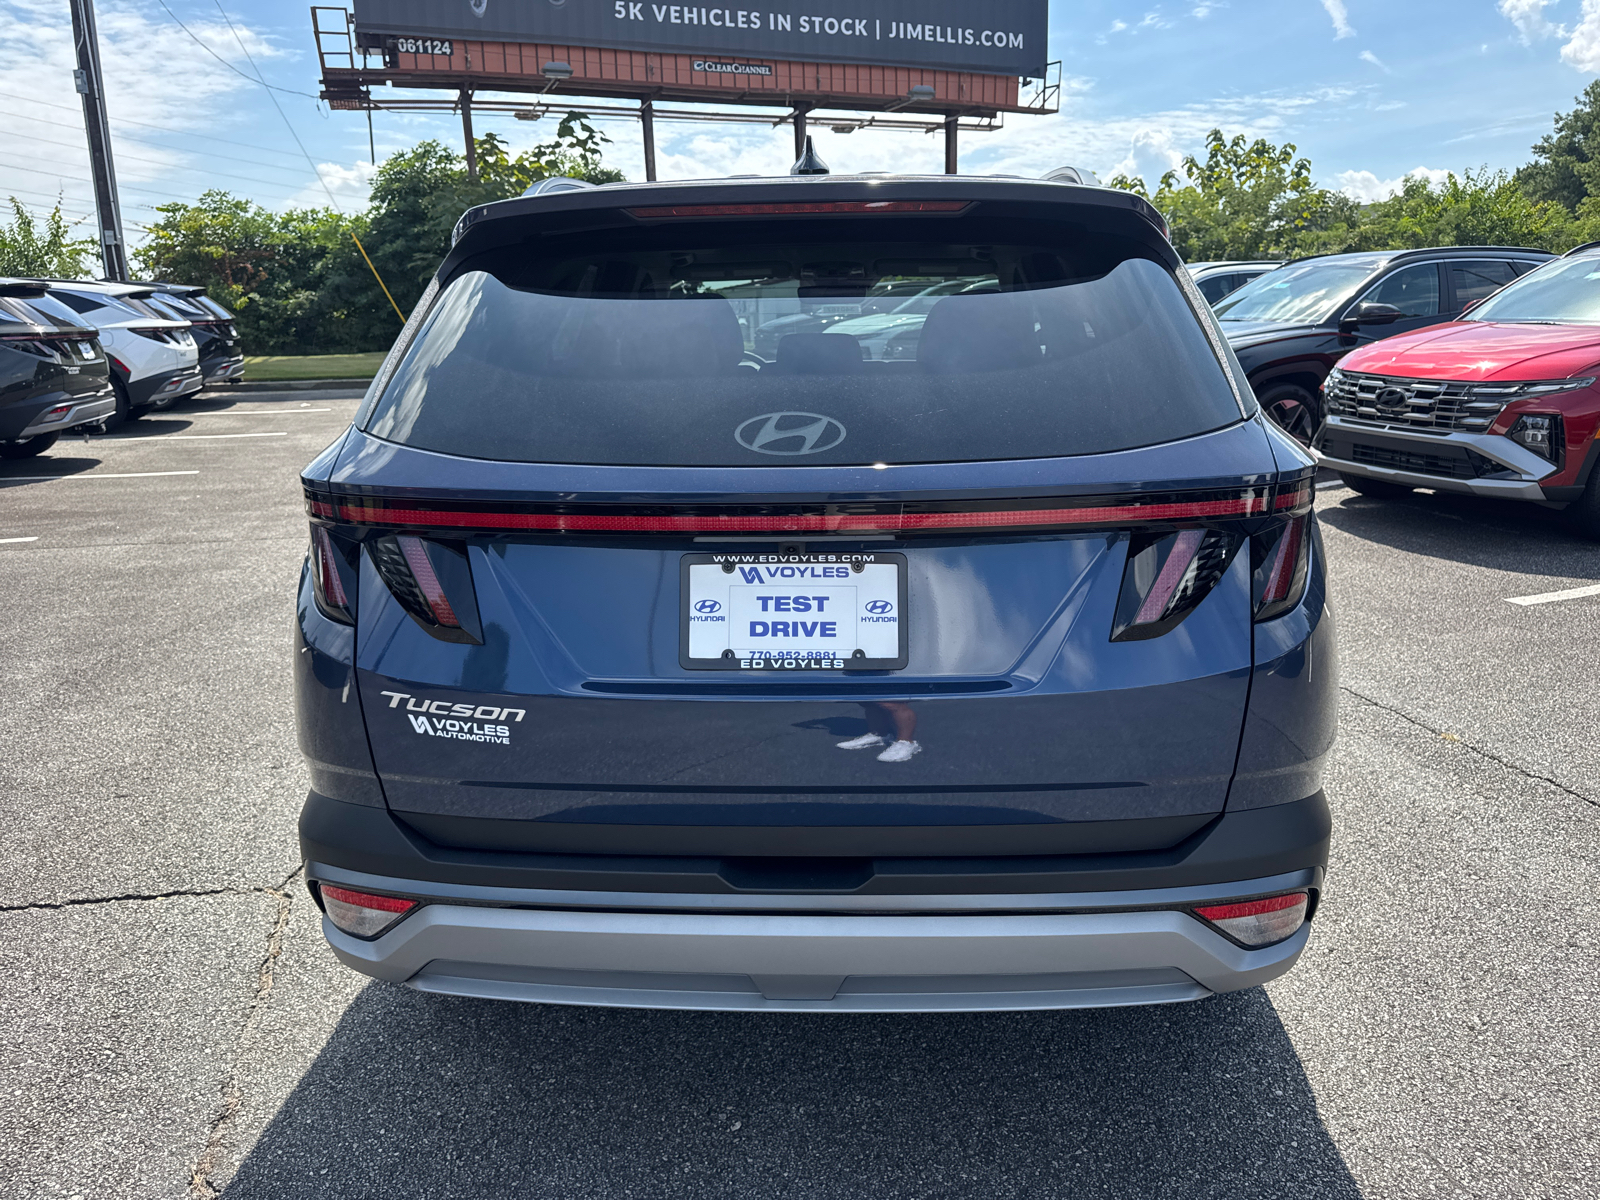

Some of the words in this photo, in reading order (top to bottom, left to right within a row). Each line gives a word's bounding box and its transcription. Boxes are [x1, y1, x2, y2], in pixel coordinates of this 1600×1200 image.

[614, 1, 644, 21] 5K
[652, 4, 761, 29] VEHICLES
[769, 13, 792, 32] IN
[799, 16, 868, 36] STOCK
[889, 21, 1024, 49] JIMELLIS.COM
[398, 38, 451, 55] 061124
[765, 566, 850, 578] VOYLES
[756, 596, 830, 612] TEST
[750, 621, 837, 638] DRIVE
[749, 651, 837, 659] 770-952-8881
[740, 660, 765, 669] ED
[770, 660, 845, 669] VOYLES
[432, 717, 510, 737] VOYLES
[436, 729, 511, 744] AUTOMOTIVE
